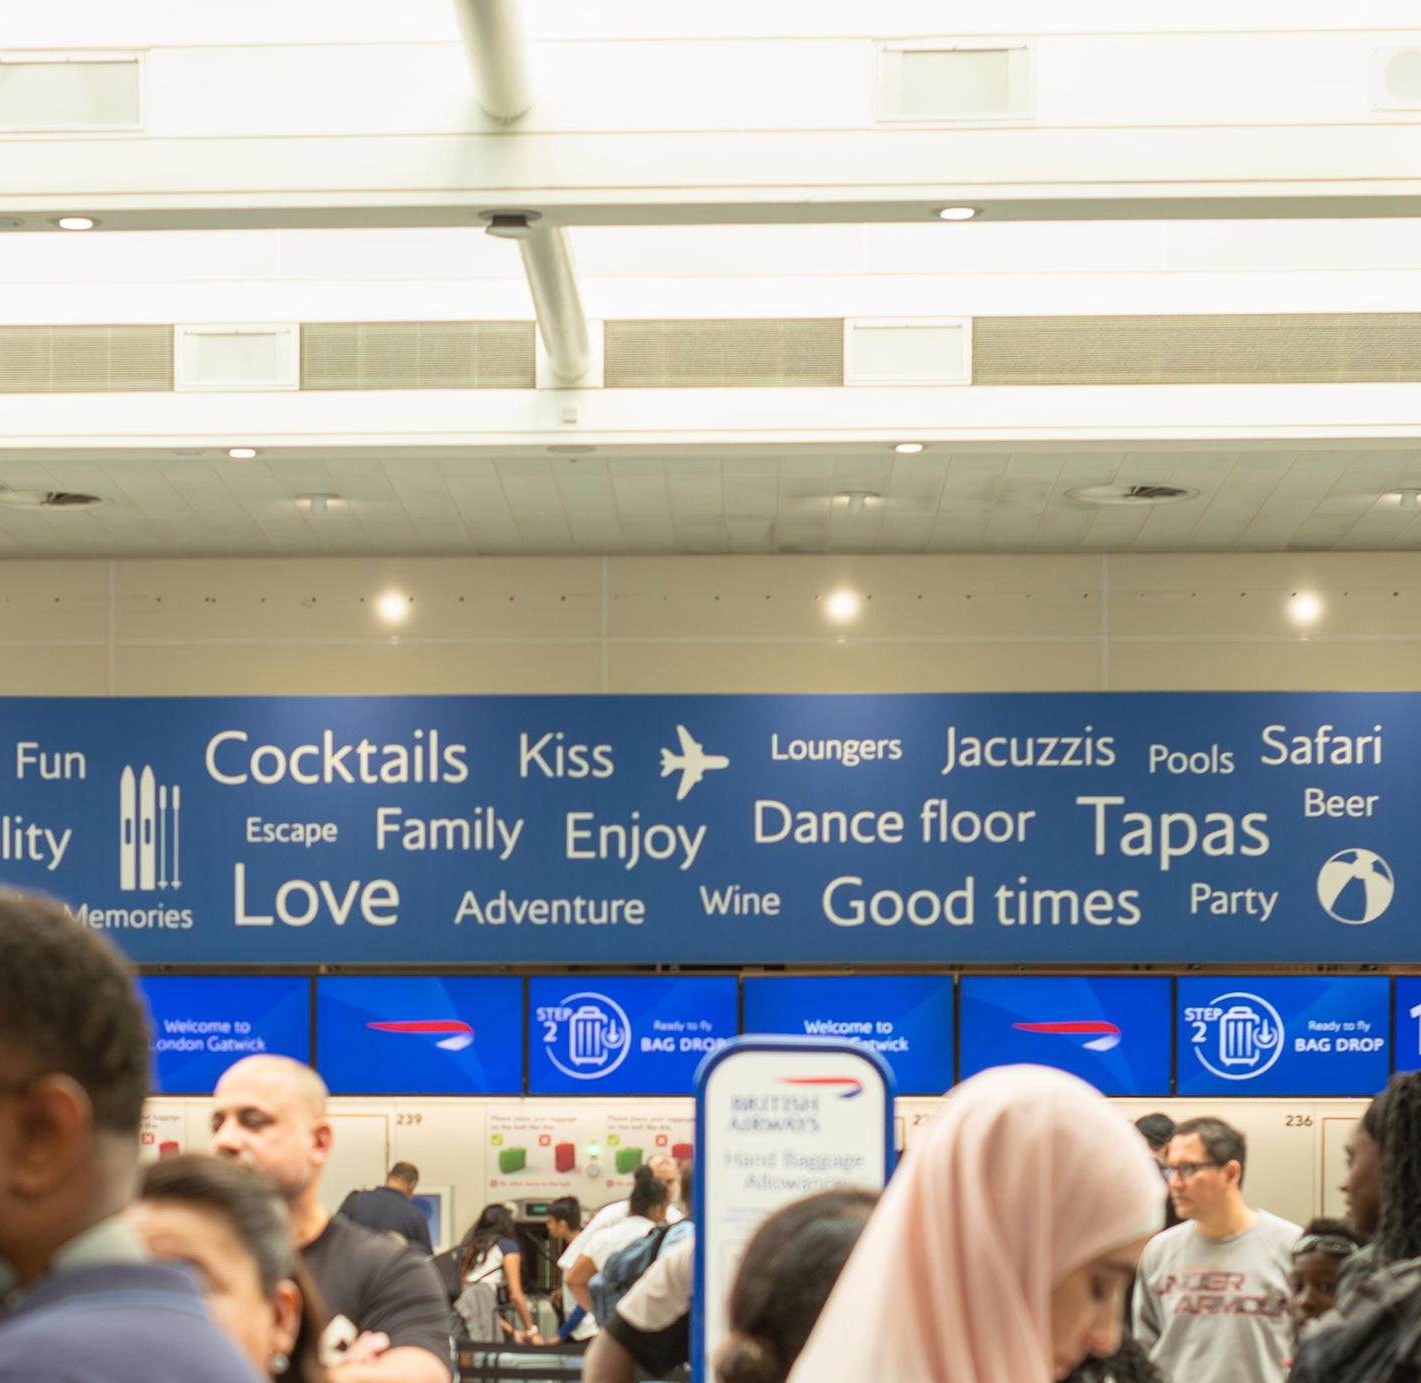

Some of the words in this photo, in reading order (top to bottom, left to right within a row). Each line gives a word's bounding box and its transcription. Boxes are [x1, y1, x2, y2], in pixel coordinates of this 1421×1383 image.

[17, 742, 86, 780] Fun
[205, 728, 469, 785] Cocktails
[520, 732, 614, 778] Kiss
[771, 732, 903, 768] Loungers
[941, 725, 1116, 775] Jacuzzis
[1149, 744, 1235, 774] Pools
[1261, 724, 1383, 766] Safari
[1304, 787, 1380, 818] Beer
[246, 816, 339, 848] Escape
[376, 806, 524, 861] Family
[754, 799, 905, 844] Dance
[919, 798, 1036, 843] floor
[1076, 796, 1270, 871] Tapas
[566, 811, 707, 871] Enjoy
[234, 862, 400, 927] Love
[454, 890, 645, 925] Adventure
[699, 884, 781, 916] Wine
[822, 875, 974, 927] Good
[994, 875, 1141, 926] times
[1191, 882, 1279, 922] Party
[64, 903, 193, 930] Memories
[163, 1019, 232, 1034] Welcome
[234, 1021, 252, 1034] to
[536, 1007, 572, 1021] STEP
[804, 1019, 873, 1035] Welcome
[876, 1021, 894, 1035] to
[1184, 1007, 1223, 1022] STEP
[1308, 1020, 1341, 1032] Ready
[1343, 1021, 1355, 1030] to
[207, 1035, 266, 1051] Gatwick
[543, 1021, 558, 1042] 2
[640, 1036, 676, 1052] BAG
[1191, 1022, 1207, 1043] 2
[1294, 1037, 1332, 1053] BAG
[1335, 1037, 1385, 1053] DROP
[396, 1113, 423, 1126] 239
[1285, 1114, 1314, 1128] 236
